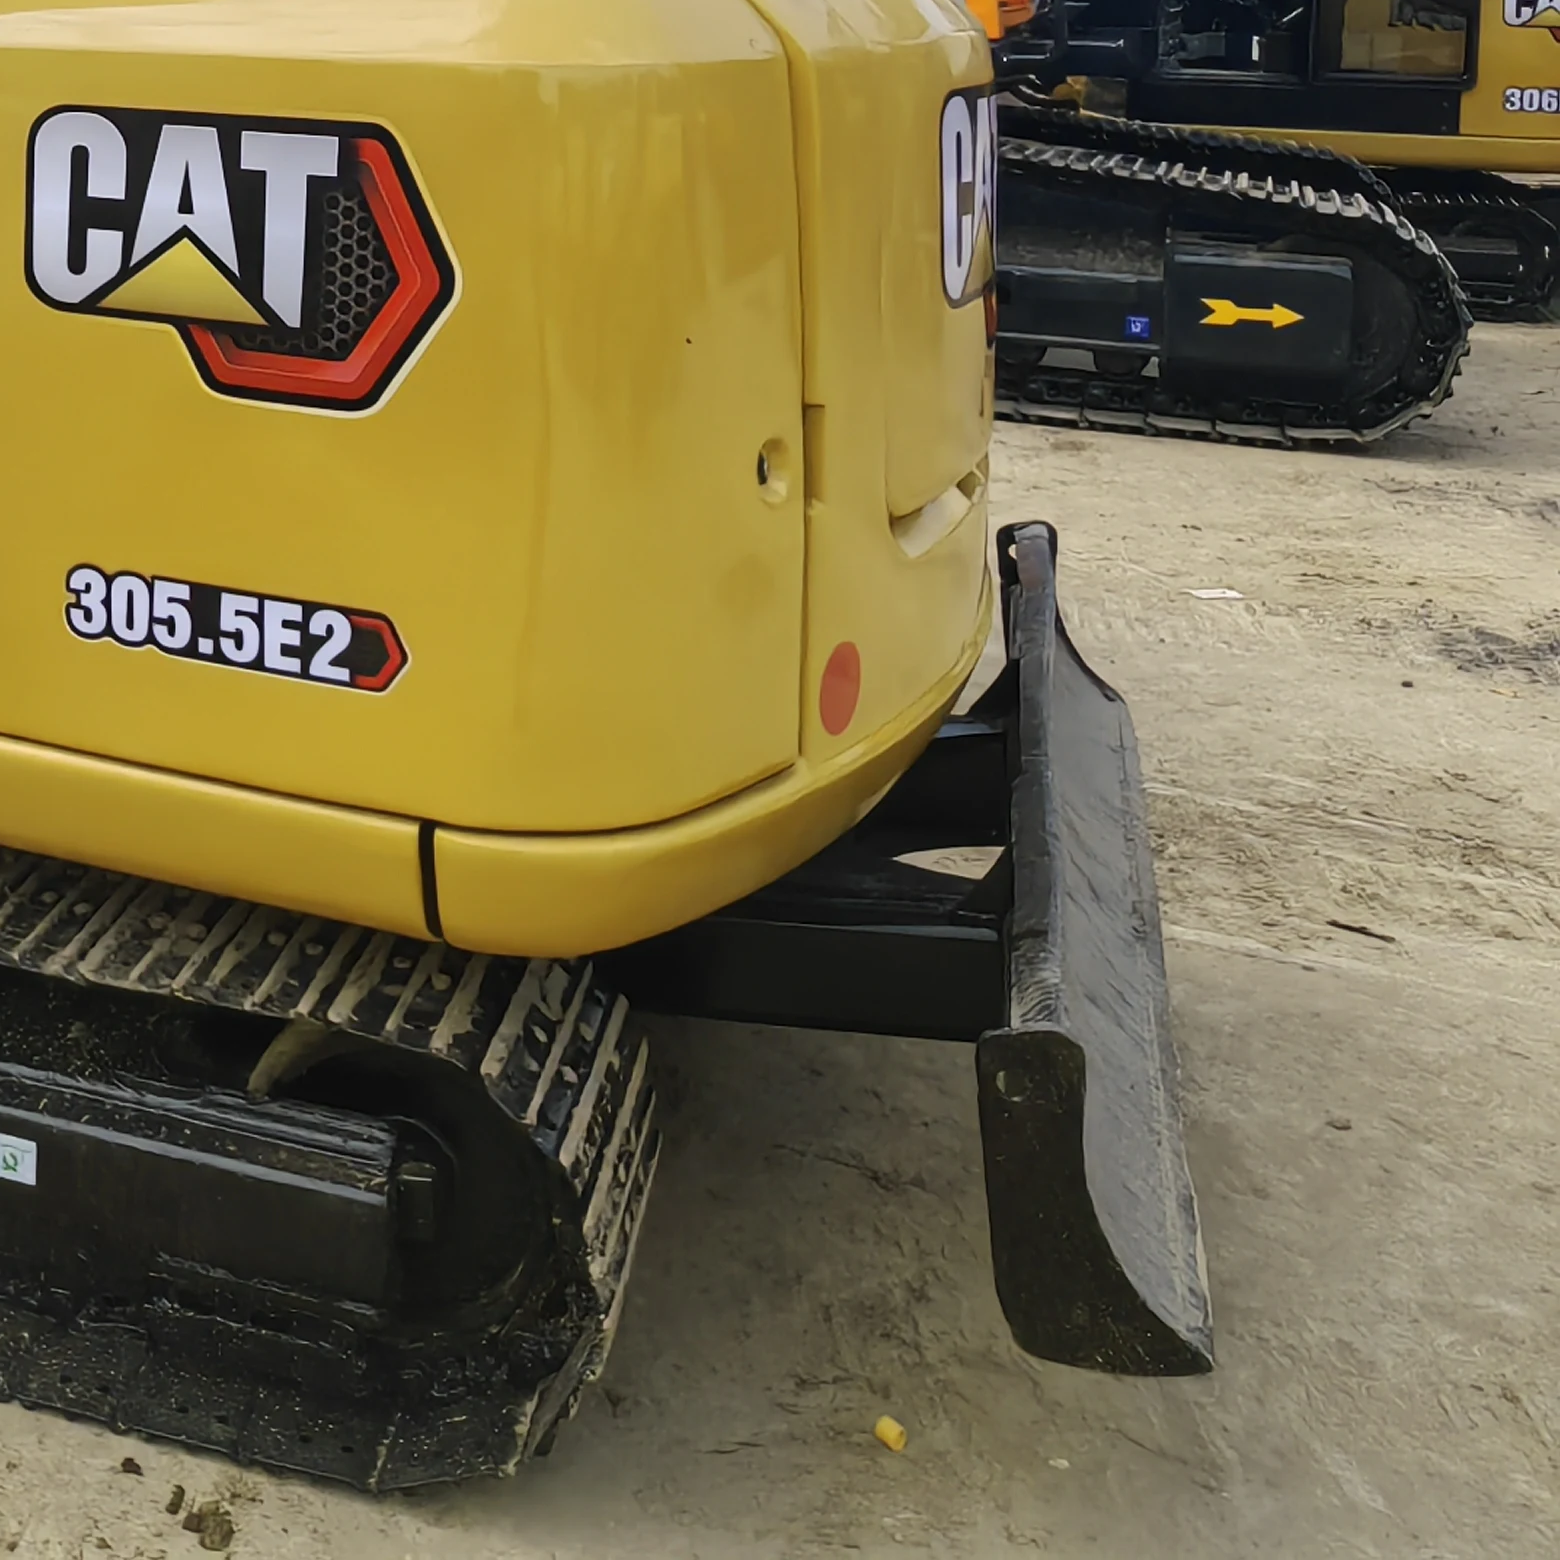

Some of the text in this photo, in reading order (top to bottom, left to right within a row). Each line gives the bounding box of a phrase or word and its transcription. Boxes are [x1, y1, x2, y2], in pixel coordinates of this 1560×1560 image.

[1505, 88, 1560, 111] 306
[32, 111, 339, 328] CAT
[942, 95, 997, 300] CA
[68, 567, 352, 682] 305.5E2
